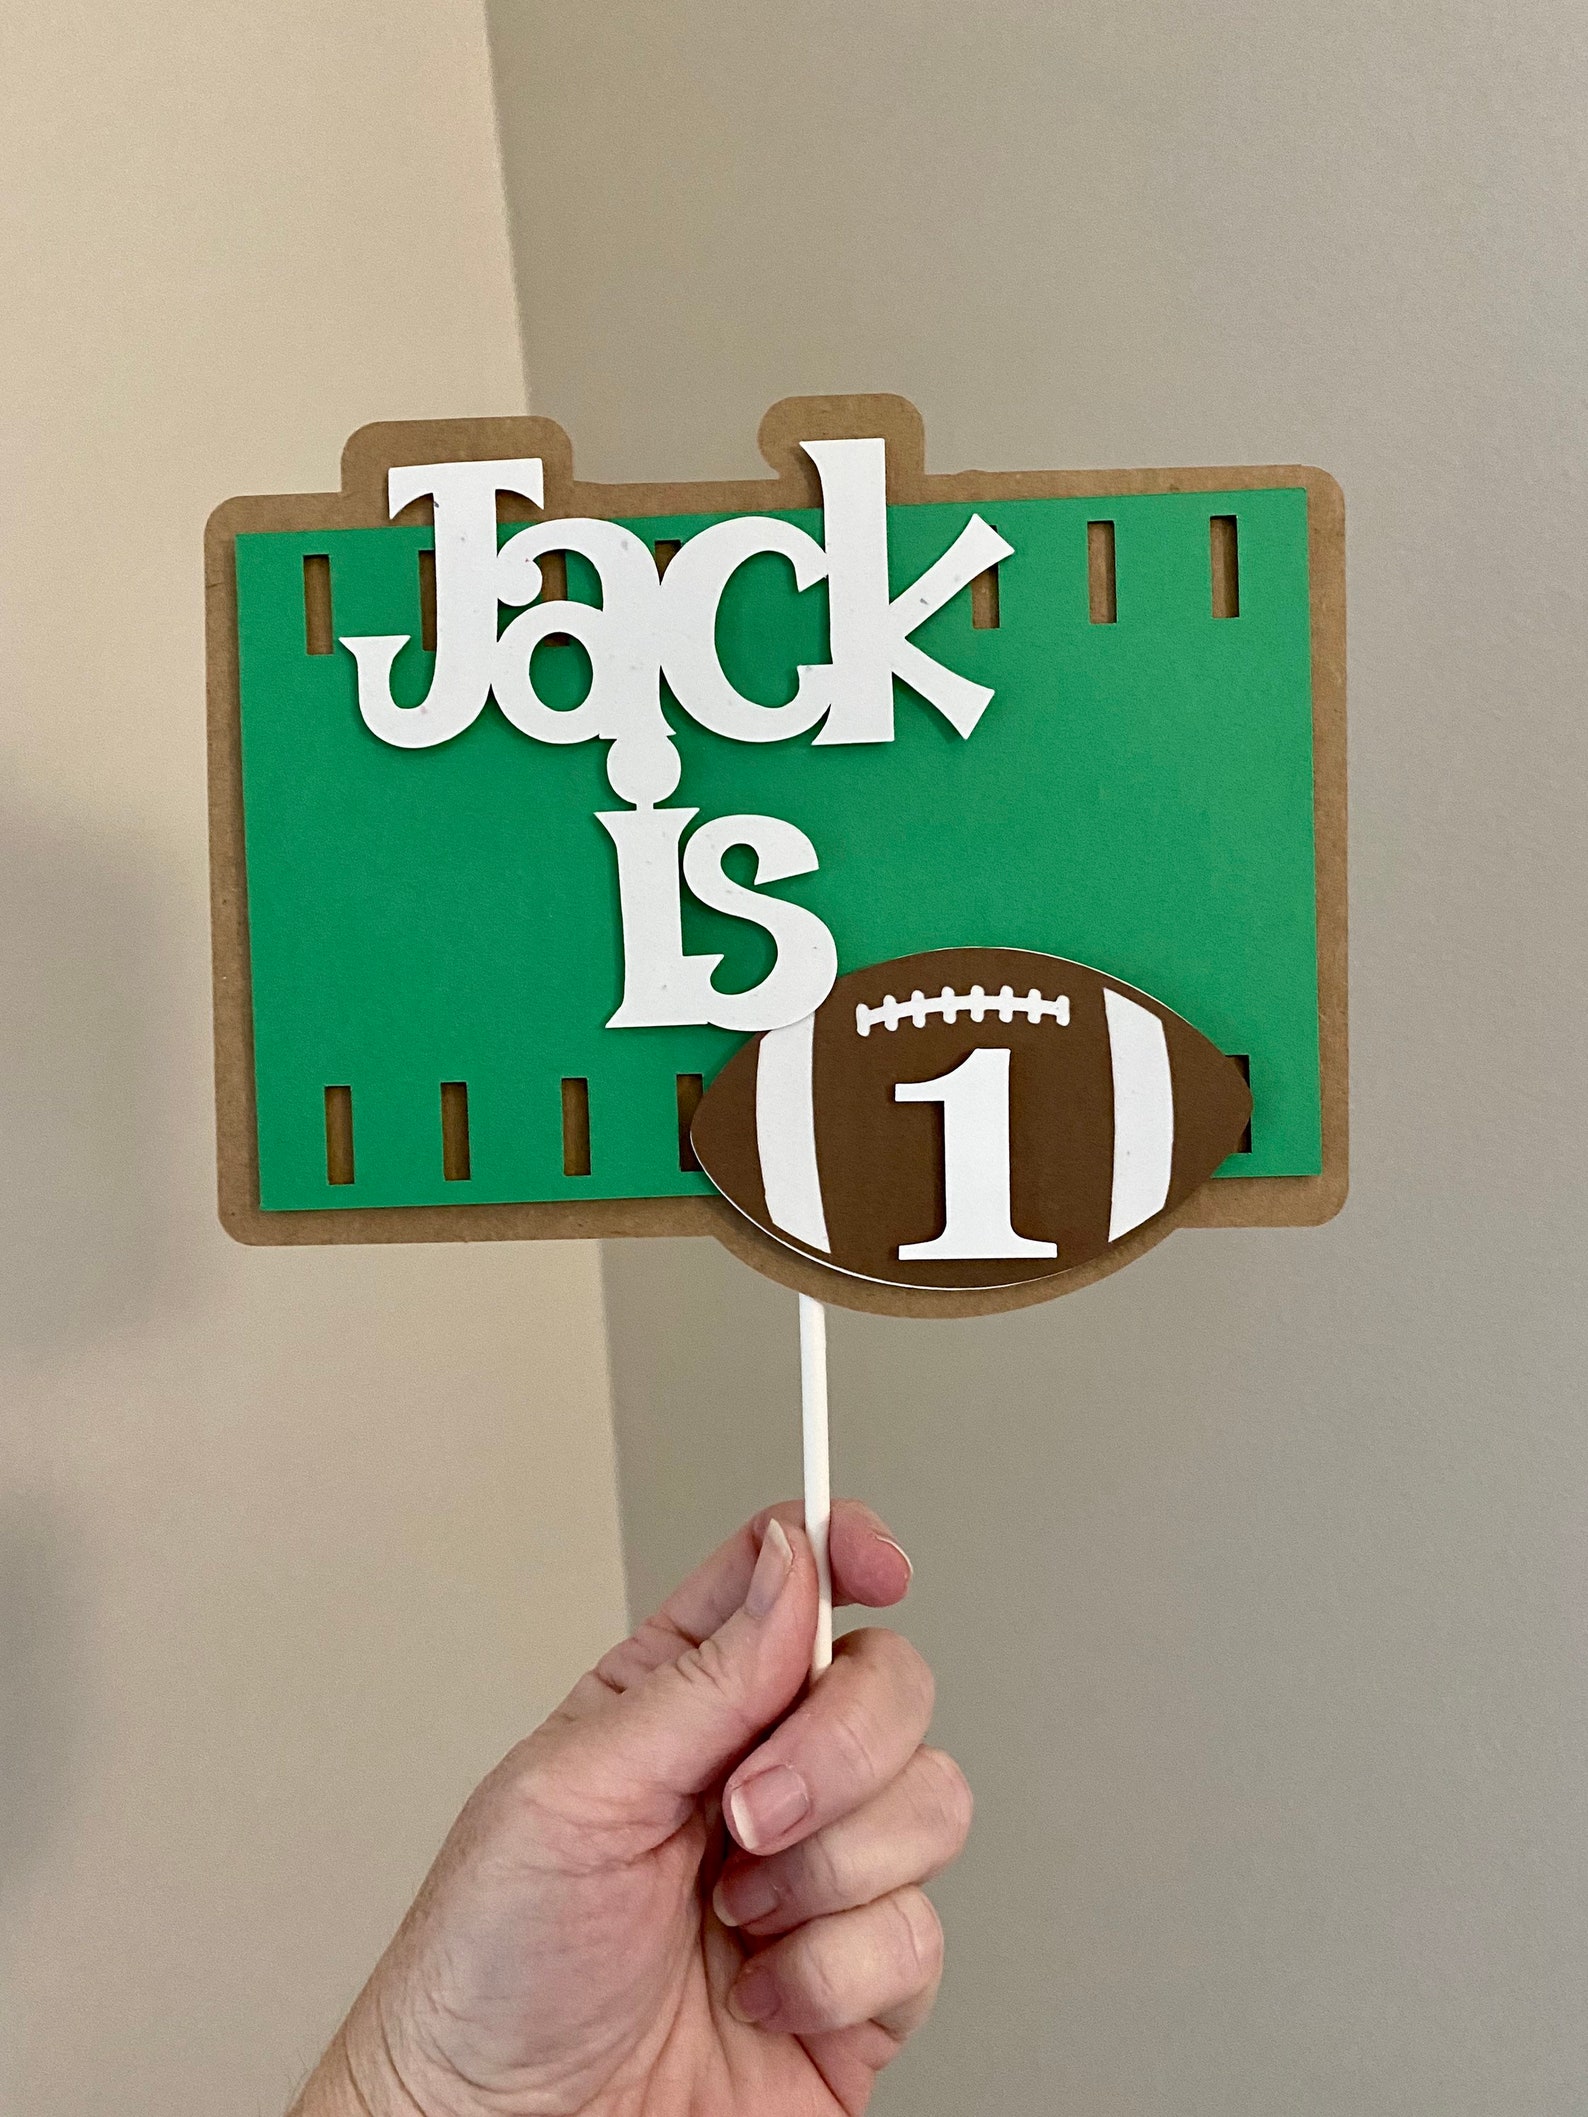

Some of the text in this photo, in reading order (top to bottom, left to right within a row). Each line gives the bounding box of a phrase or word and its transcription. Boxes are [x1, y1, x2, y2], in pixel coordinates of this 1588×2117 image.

[338, 437, 1015, 748] Jack
[593, 730, 839, 1032] is
[894, 1047, 1058, 1261] 1
